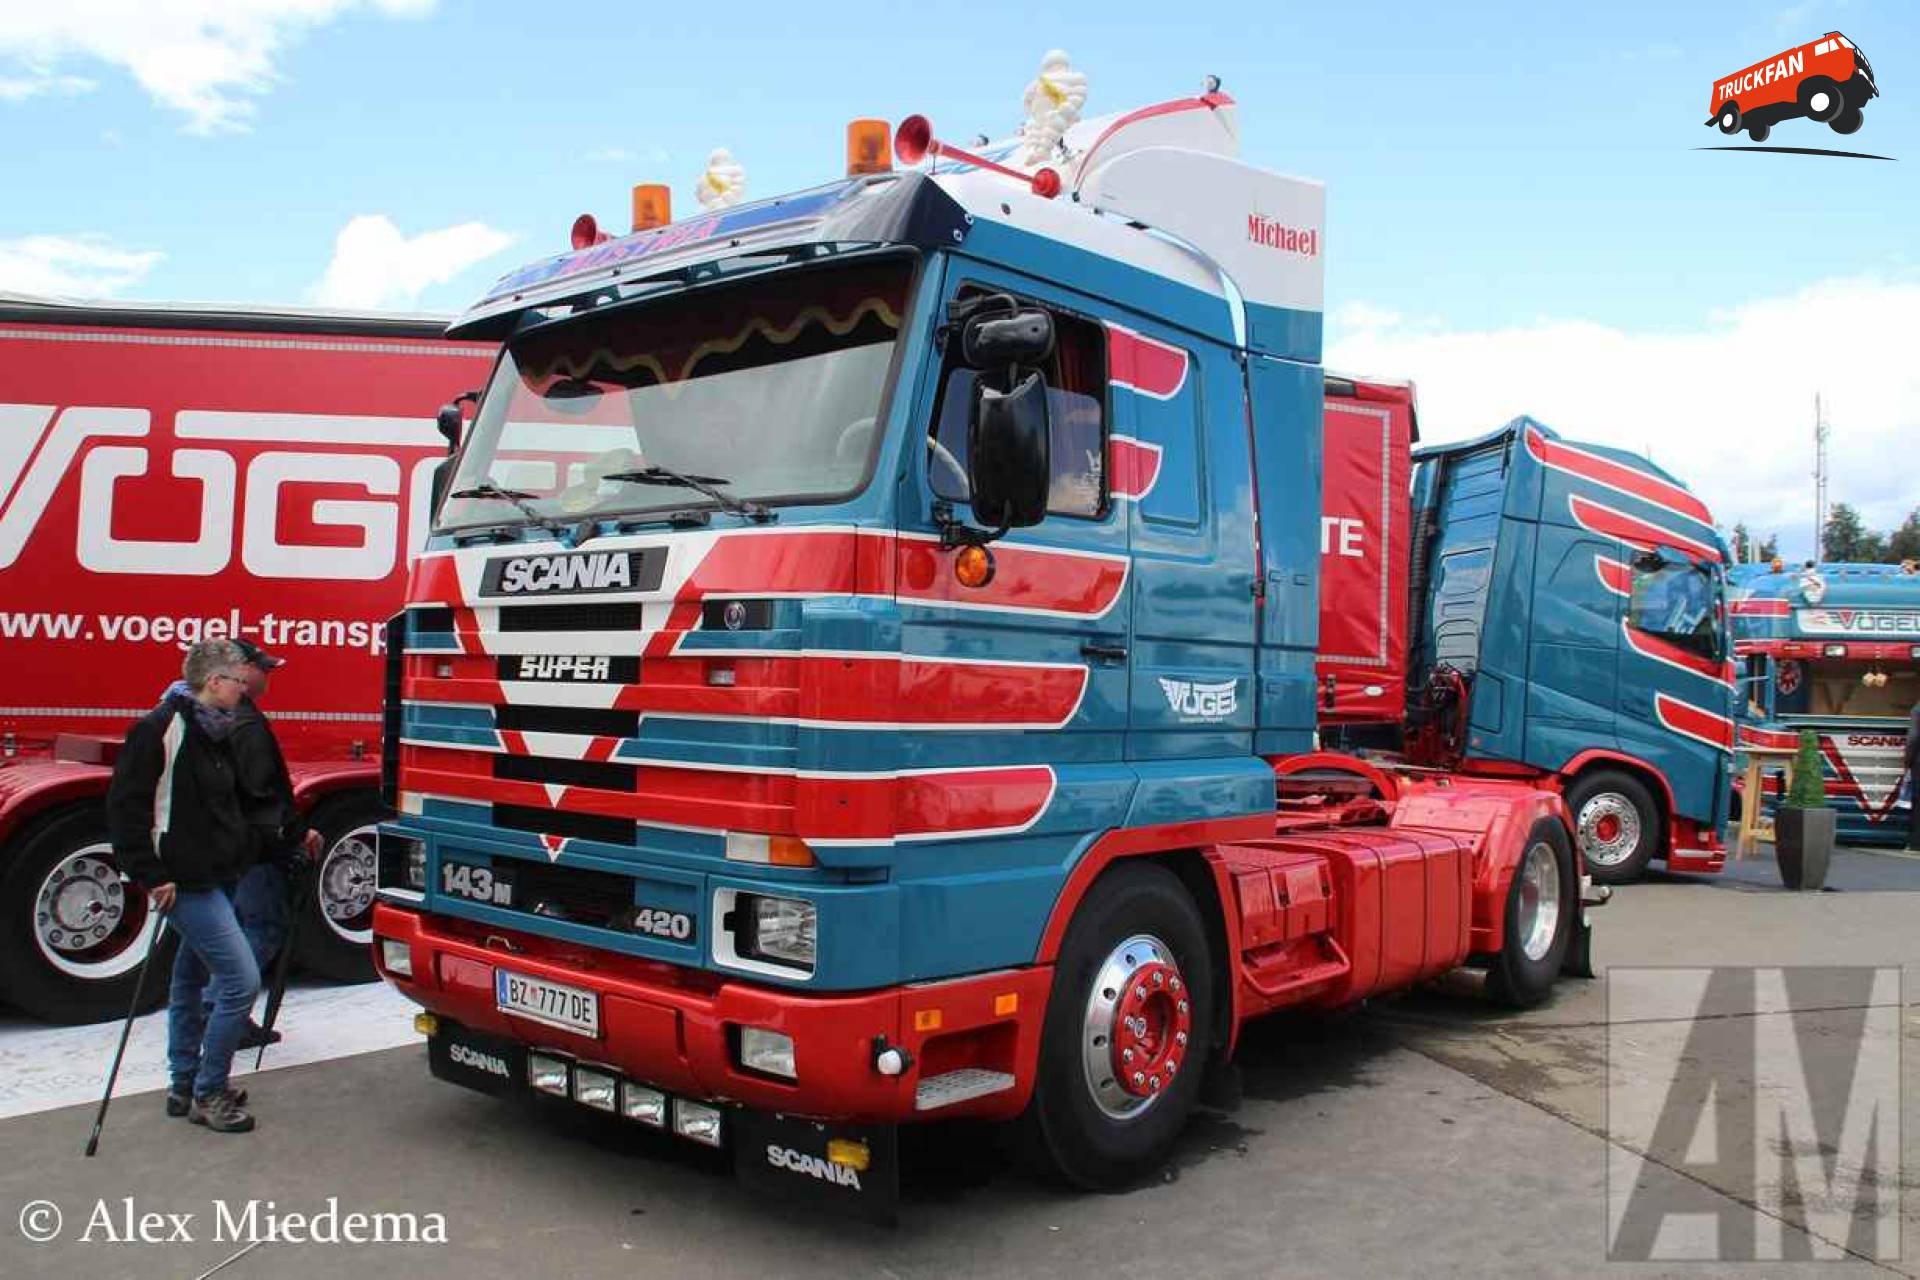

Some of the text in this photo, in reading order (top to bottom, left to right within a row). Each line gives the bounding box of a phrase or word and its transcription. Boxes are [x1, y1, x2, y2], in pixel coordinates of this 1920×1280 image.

[1248, 214, 1317, 256] Michael
[502, 551, 631, 592] SCANIA
[520, 655, 610, 681] SUPER
[634, 909, 691, 940] 420
[510, 979, 592, 1023] BZ 777 DE
[450, 1043, 510, 1078] SCANIA
[767, 1144, 861, 1192] SCANIA
